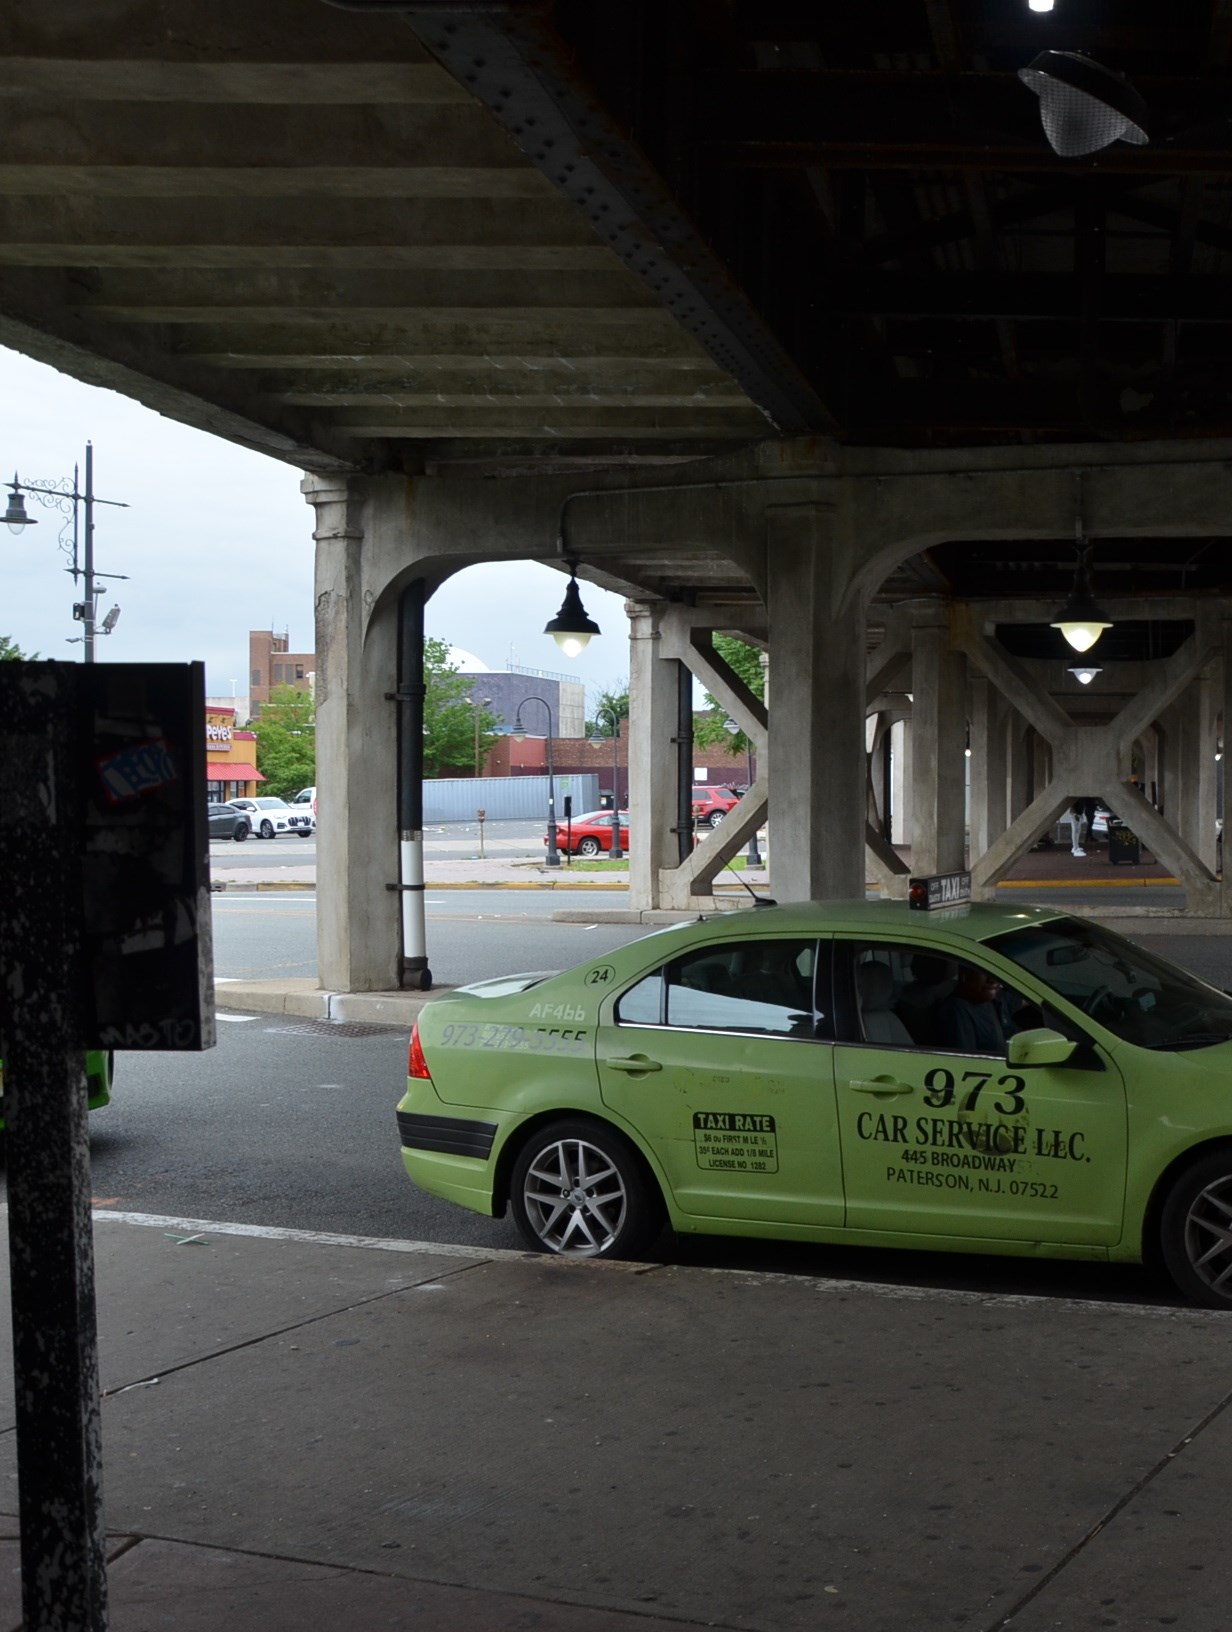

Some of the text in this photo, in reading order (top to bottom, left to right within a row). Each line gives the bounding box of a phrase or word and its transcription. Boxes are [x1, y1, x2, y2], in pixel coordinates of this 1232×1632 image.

[941, 876, 960, 901] TAXI
[590, 969, 609, 984] 24
[923, 1068, 1026, 1115] 973
[698, 1114, 771, 1131] TAXI RATE
[722, 1135, 740, 1144] FIRST
[857, 1112, 909, 1144] CAR
[915, 1117, 1027, 1155] SERVICE
[711, 1147, 729, 1156] EACH
[731, 1148, 744, 1157] ADD
[758, 1150, 775, 1158] MILE
[901, 1149, 1016, 1173] 445 BROADWAY
[709, 1159, 736, 1169] LICENSE
[886, 1167, 1059, 1199] PATERSON, N.J. 07522
